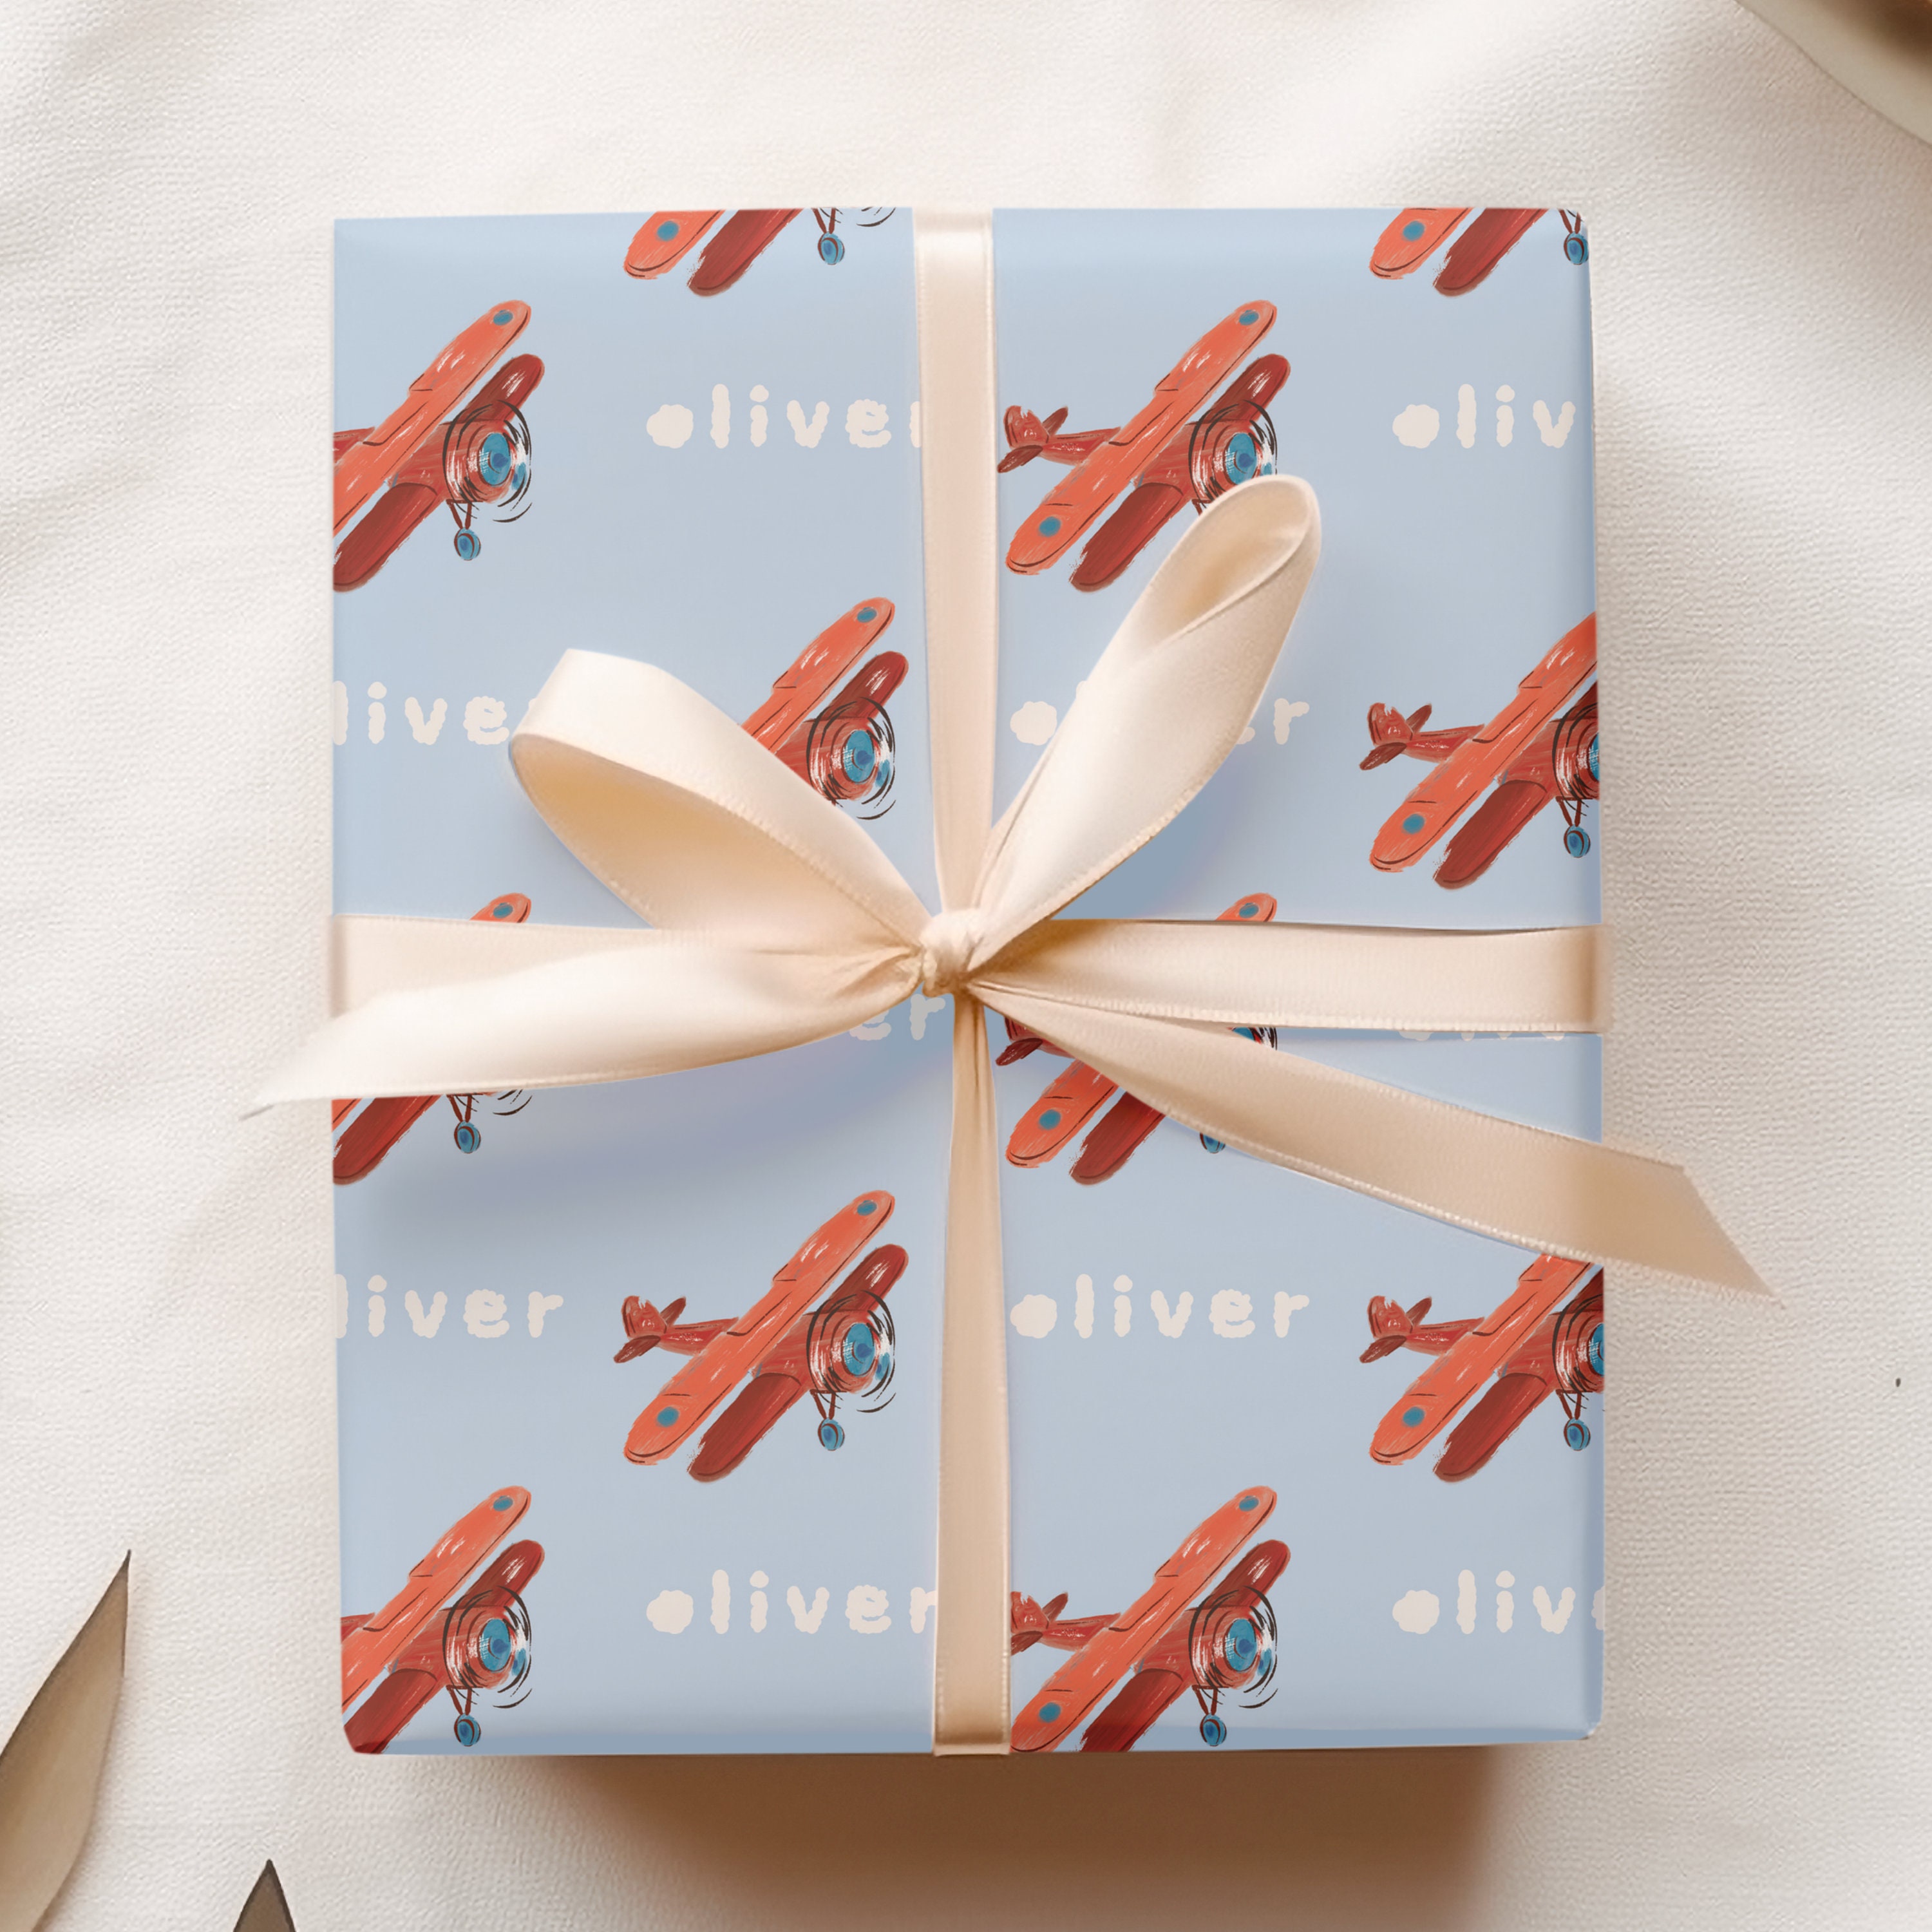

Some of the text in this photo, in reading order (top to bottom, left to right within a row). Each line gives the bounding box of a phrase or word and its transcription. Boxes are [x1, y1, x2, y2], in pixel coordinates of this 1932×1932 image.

[332, 681, 537, 745] live
[1010, 1274, 1309, 1339] oliver
[646, 1569, 938, 1634] oliver
